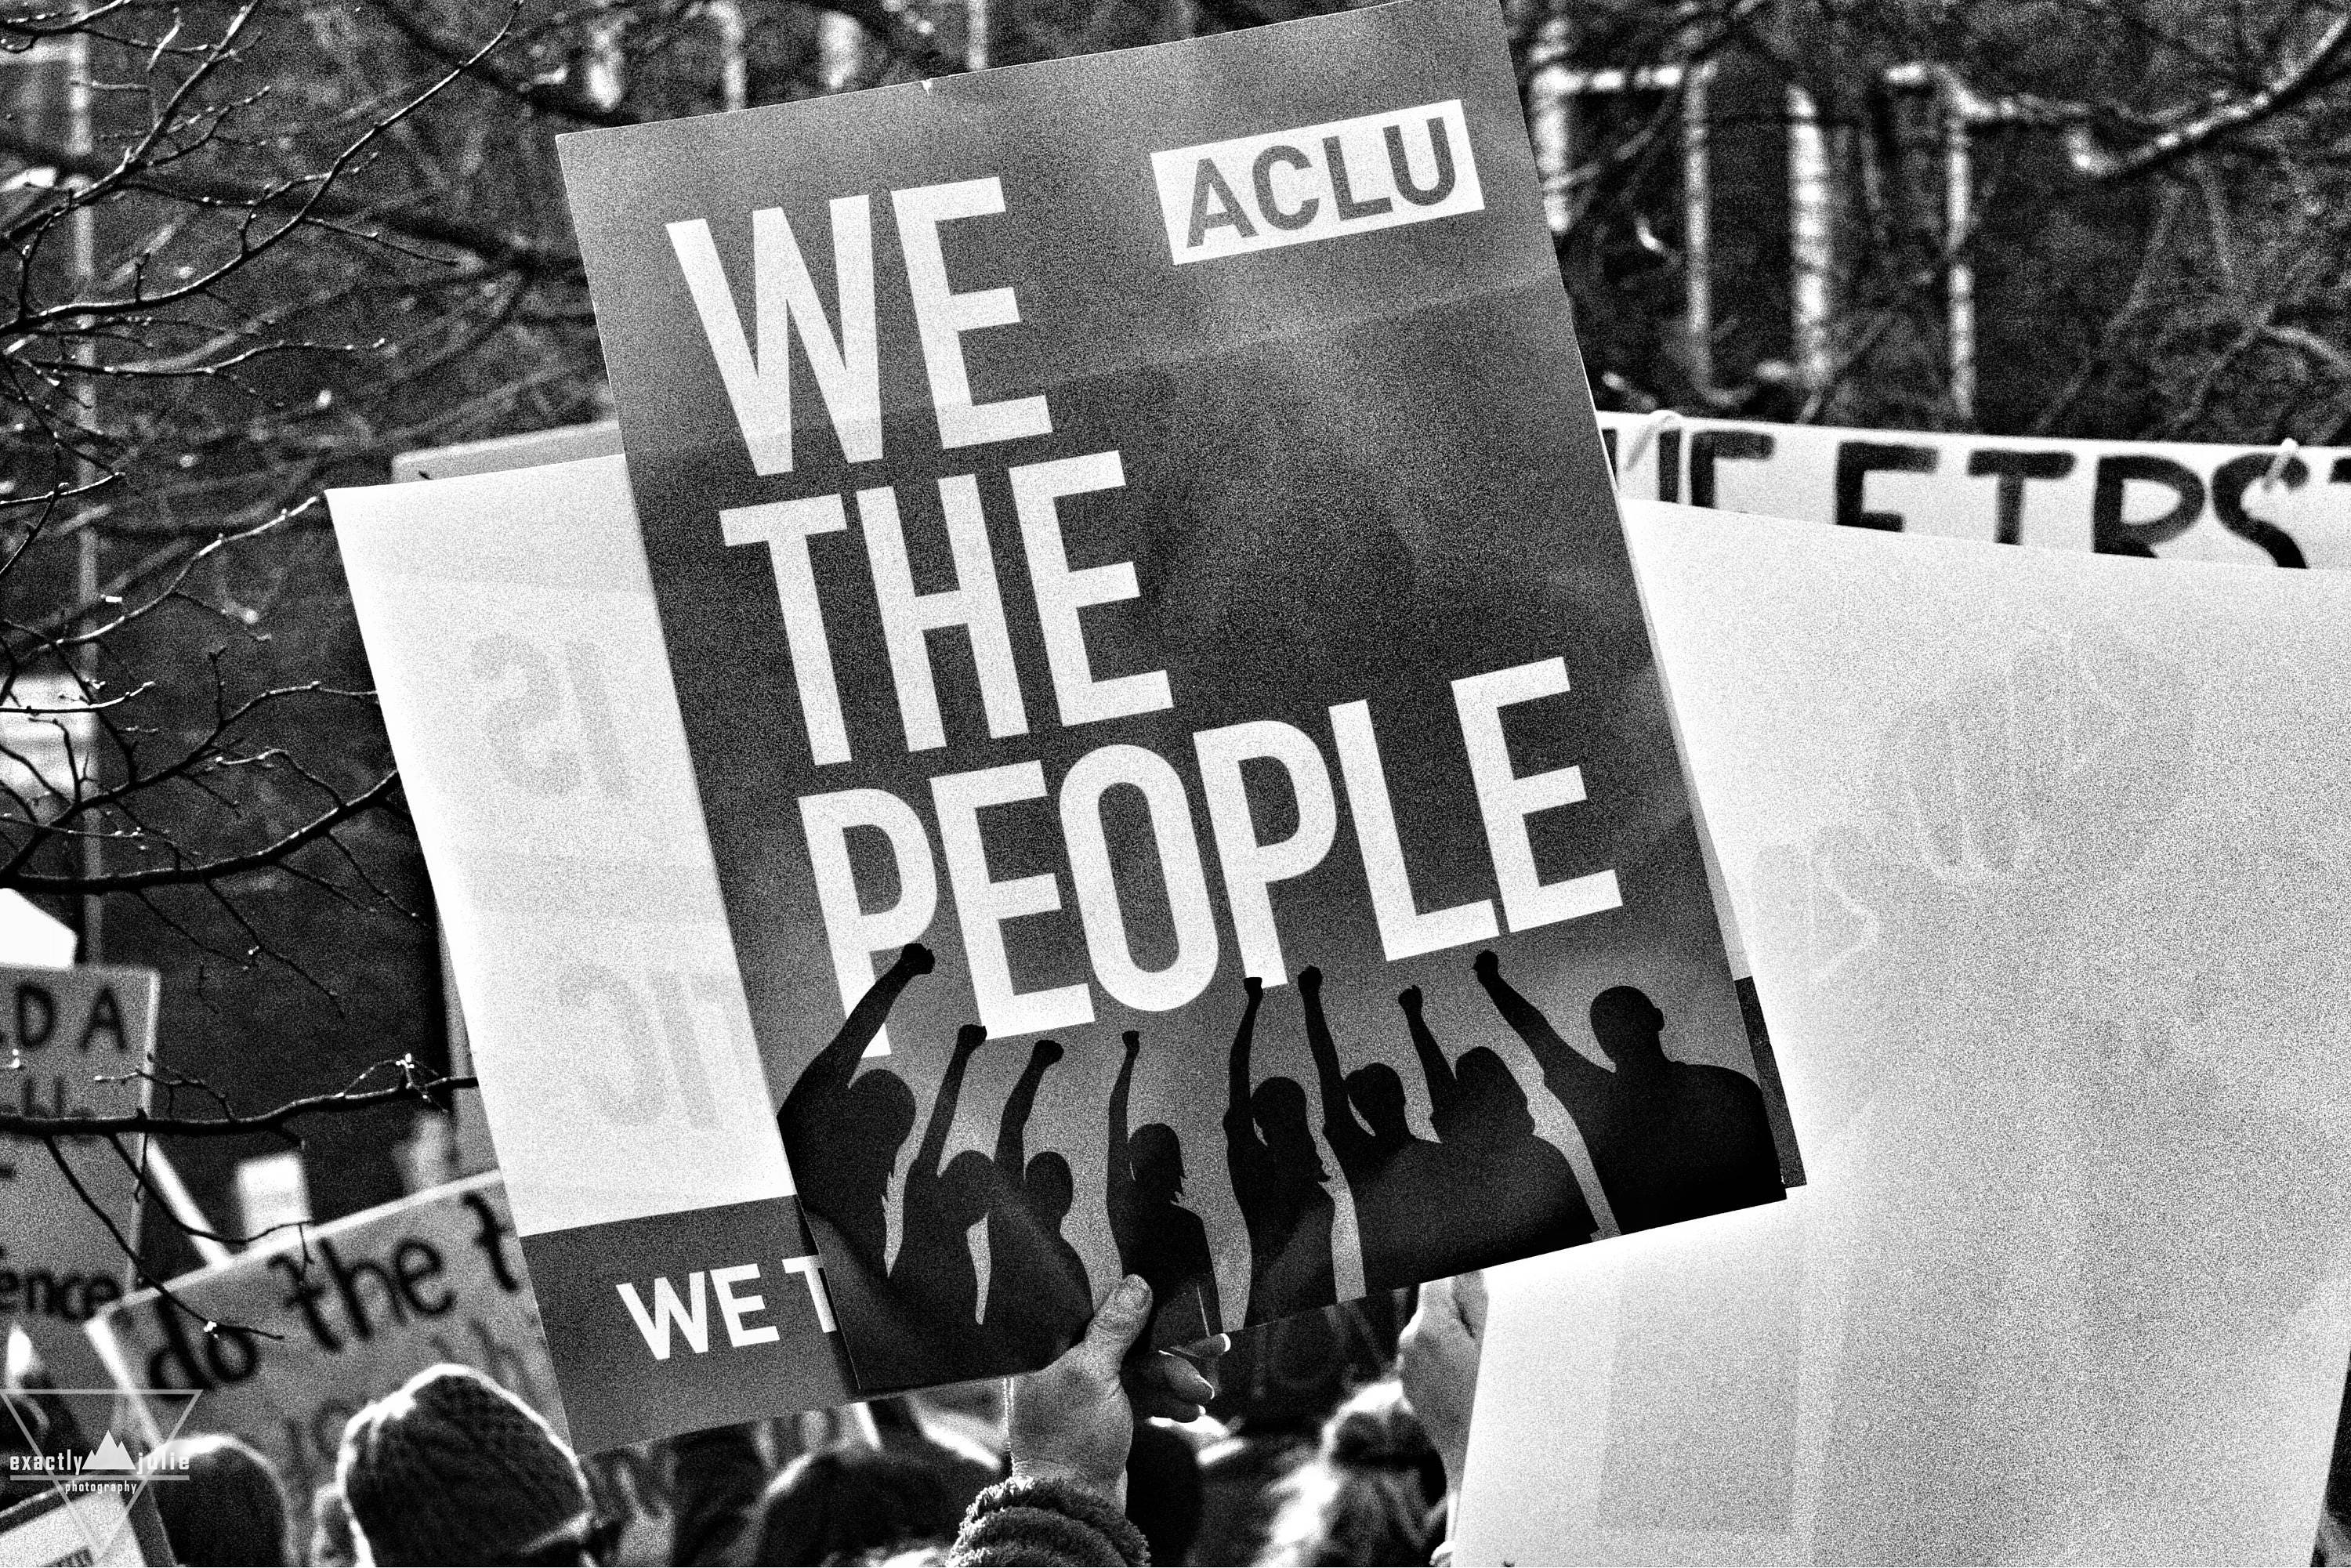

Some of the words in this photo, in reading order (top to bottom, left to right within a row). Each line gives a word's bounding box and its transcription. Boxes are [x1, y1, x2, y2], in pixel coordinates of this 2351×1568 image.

[1186, 117, 1457, 248] ACLU
[666, 176, 1052, 476] WE
[719, 450, 1174, 766] THE
[798, 657, 1623, 1059] PEOPLE
[149, 1293, 258, 1398] do
[268, 1239, 457, 1352] the
[616, 1263, 781, 1360] WE
